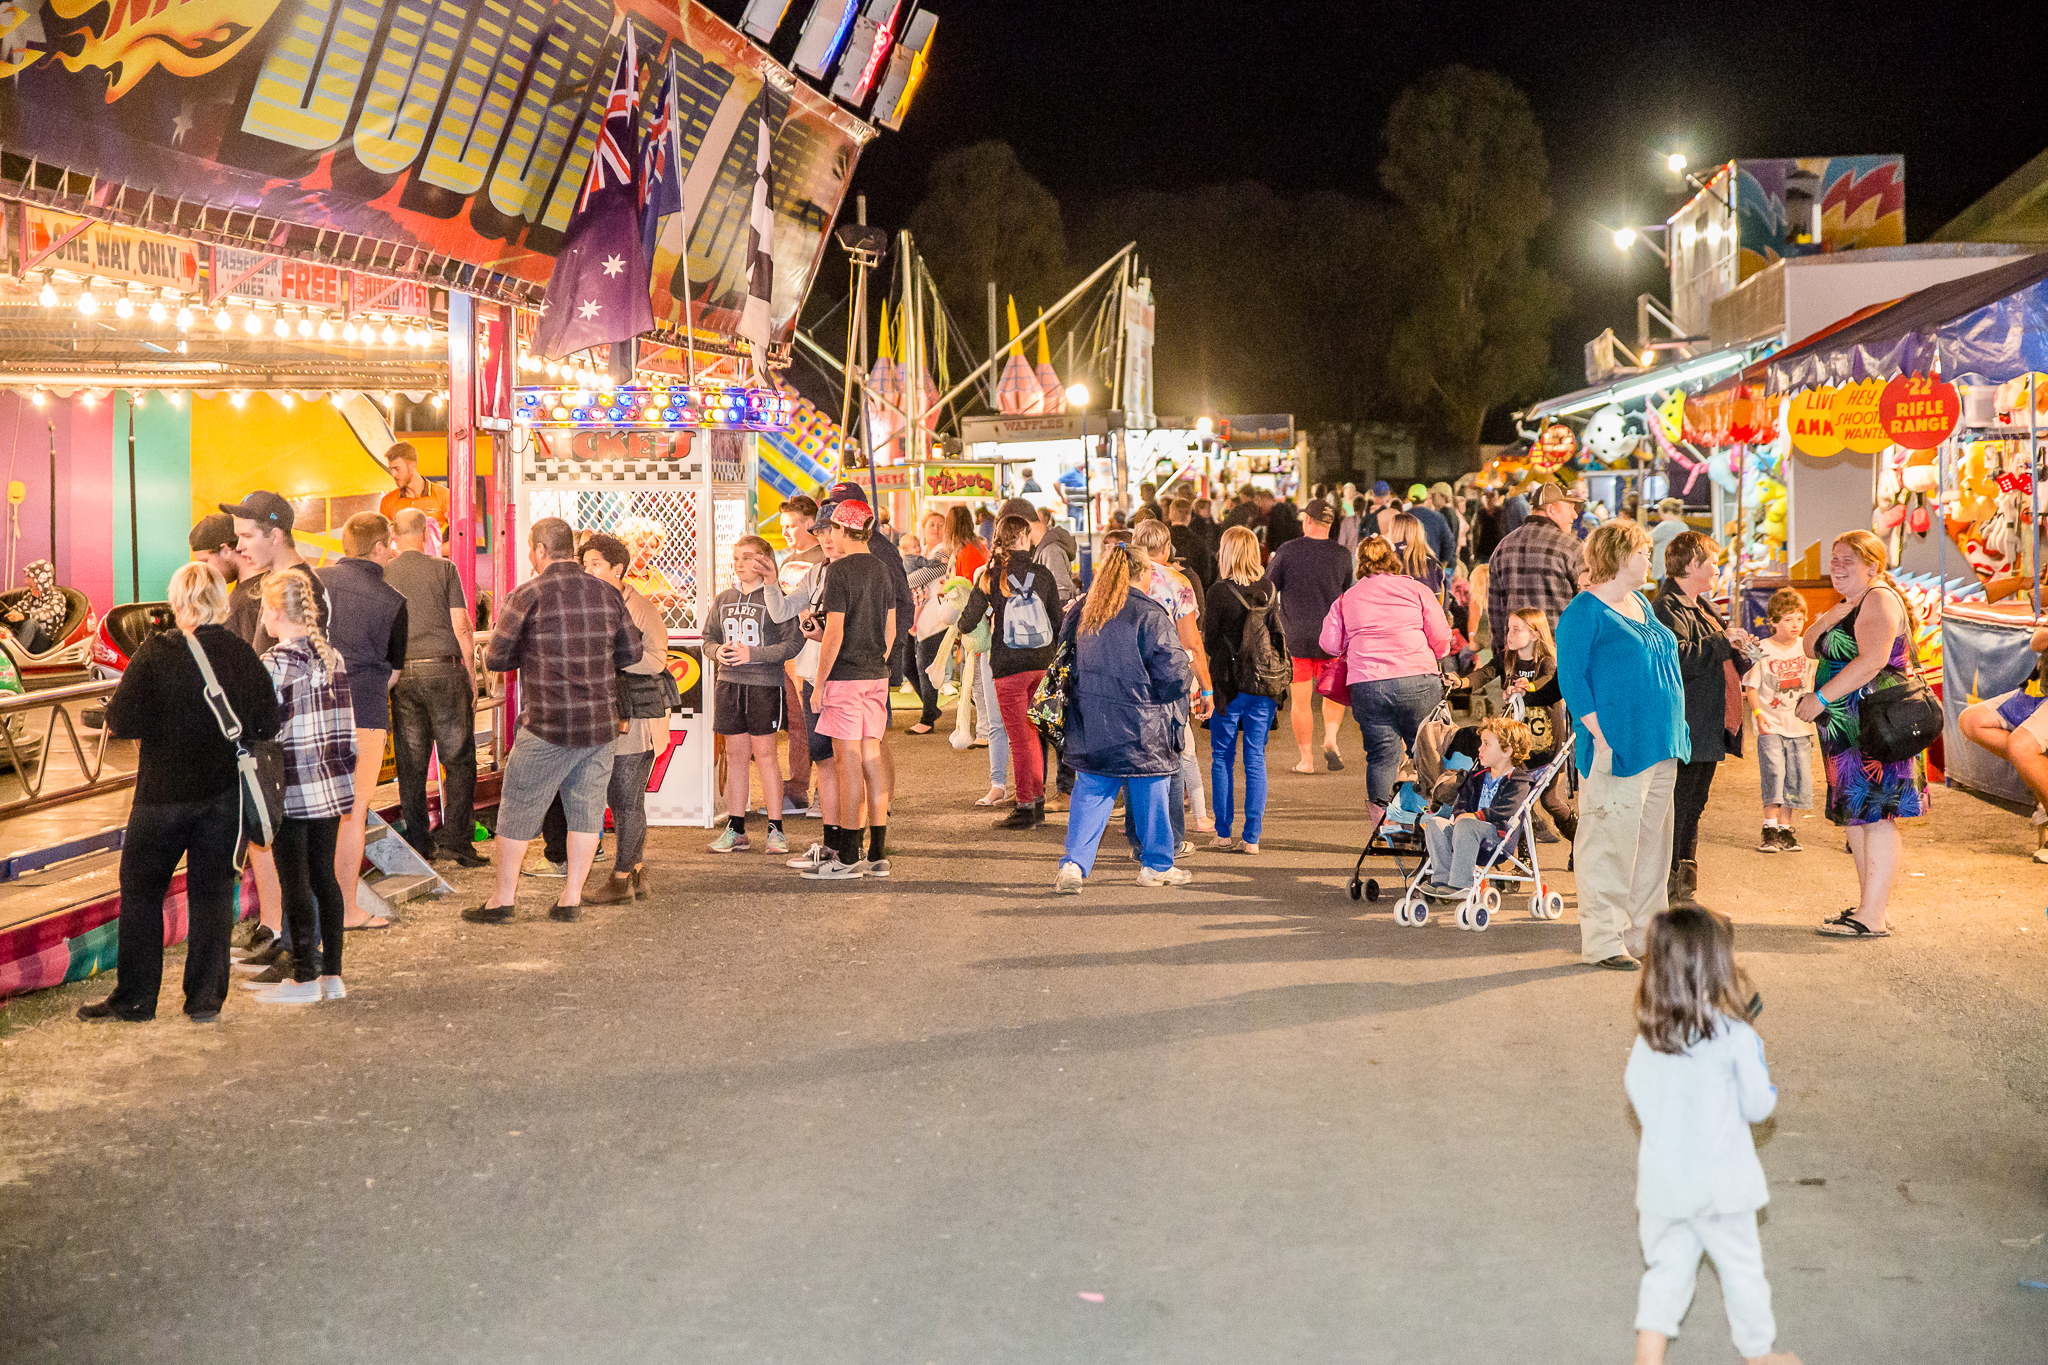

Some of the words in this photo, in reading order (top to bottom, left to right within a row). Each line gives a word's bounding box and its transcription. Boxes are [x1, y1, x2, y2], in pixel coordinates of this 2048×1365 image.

[53, 222, 90, 264] ONE
[95, 230, 131, 272] WAY
[138, 239, 178, 279] ONLY
[215, 248, 278, 276] PASSENER
[281, 260, 337, 304] FREE
[401, 281, 428, 309] FAST
[1835, 411, 1882, 426] SHOOT
[1896, 399, 1944, 417] RIFLE
[1003, 419, 1064, 432] WAFFLES
[1794, 417, 1835, 437] AMM
[1890, 416, 1949, 434] RANGE
[926, 472, 993, 496] Tickets
[728, 606, 757, 617] PARIS
[723, 617, 760, 647] 88
